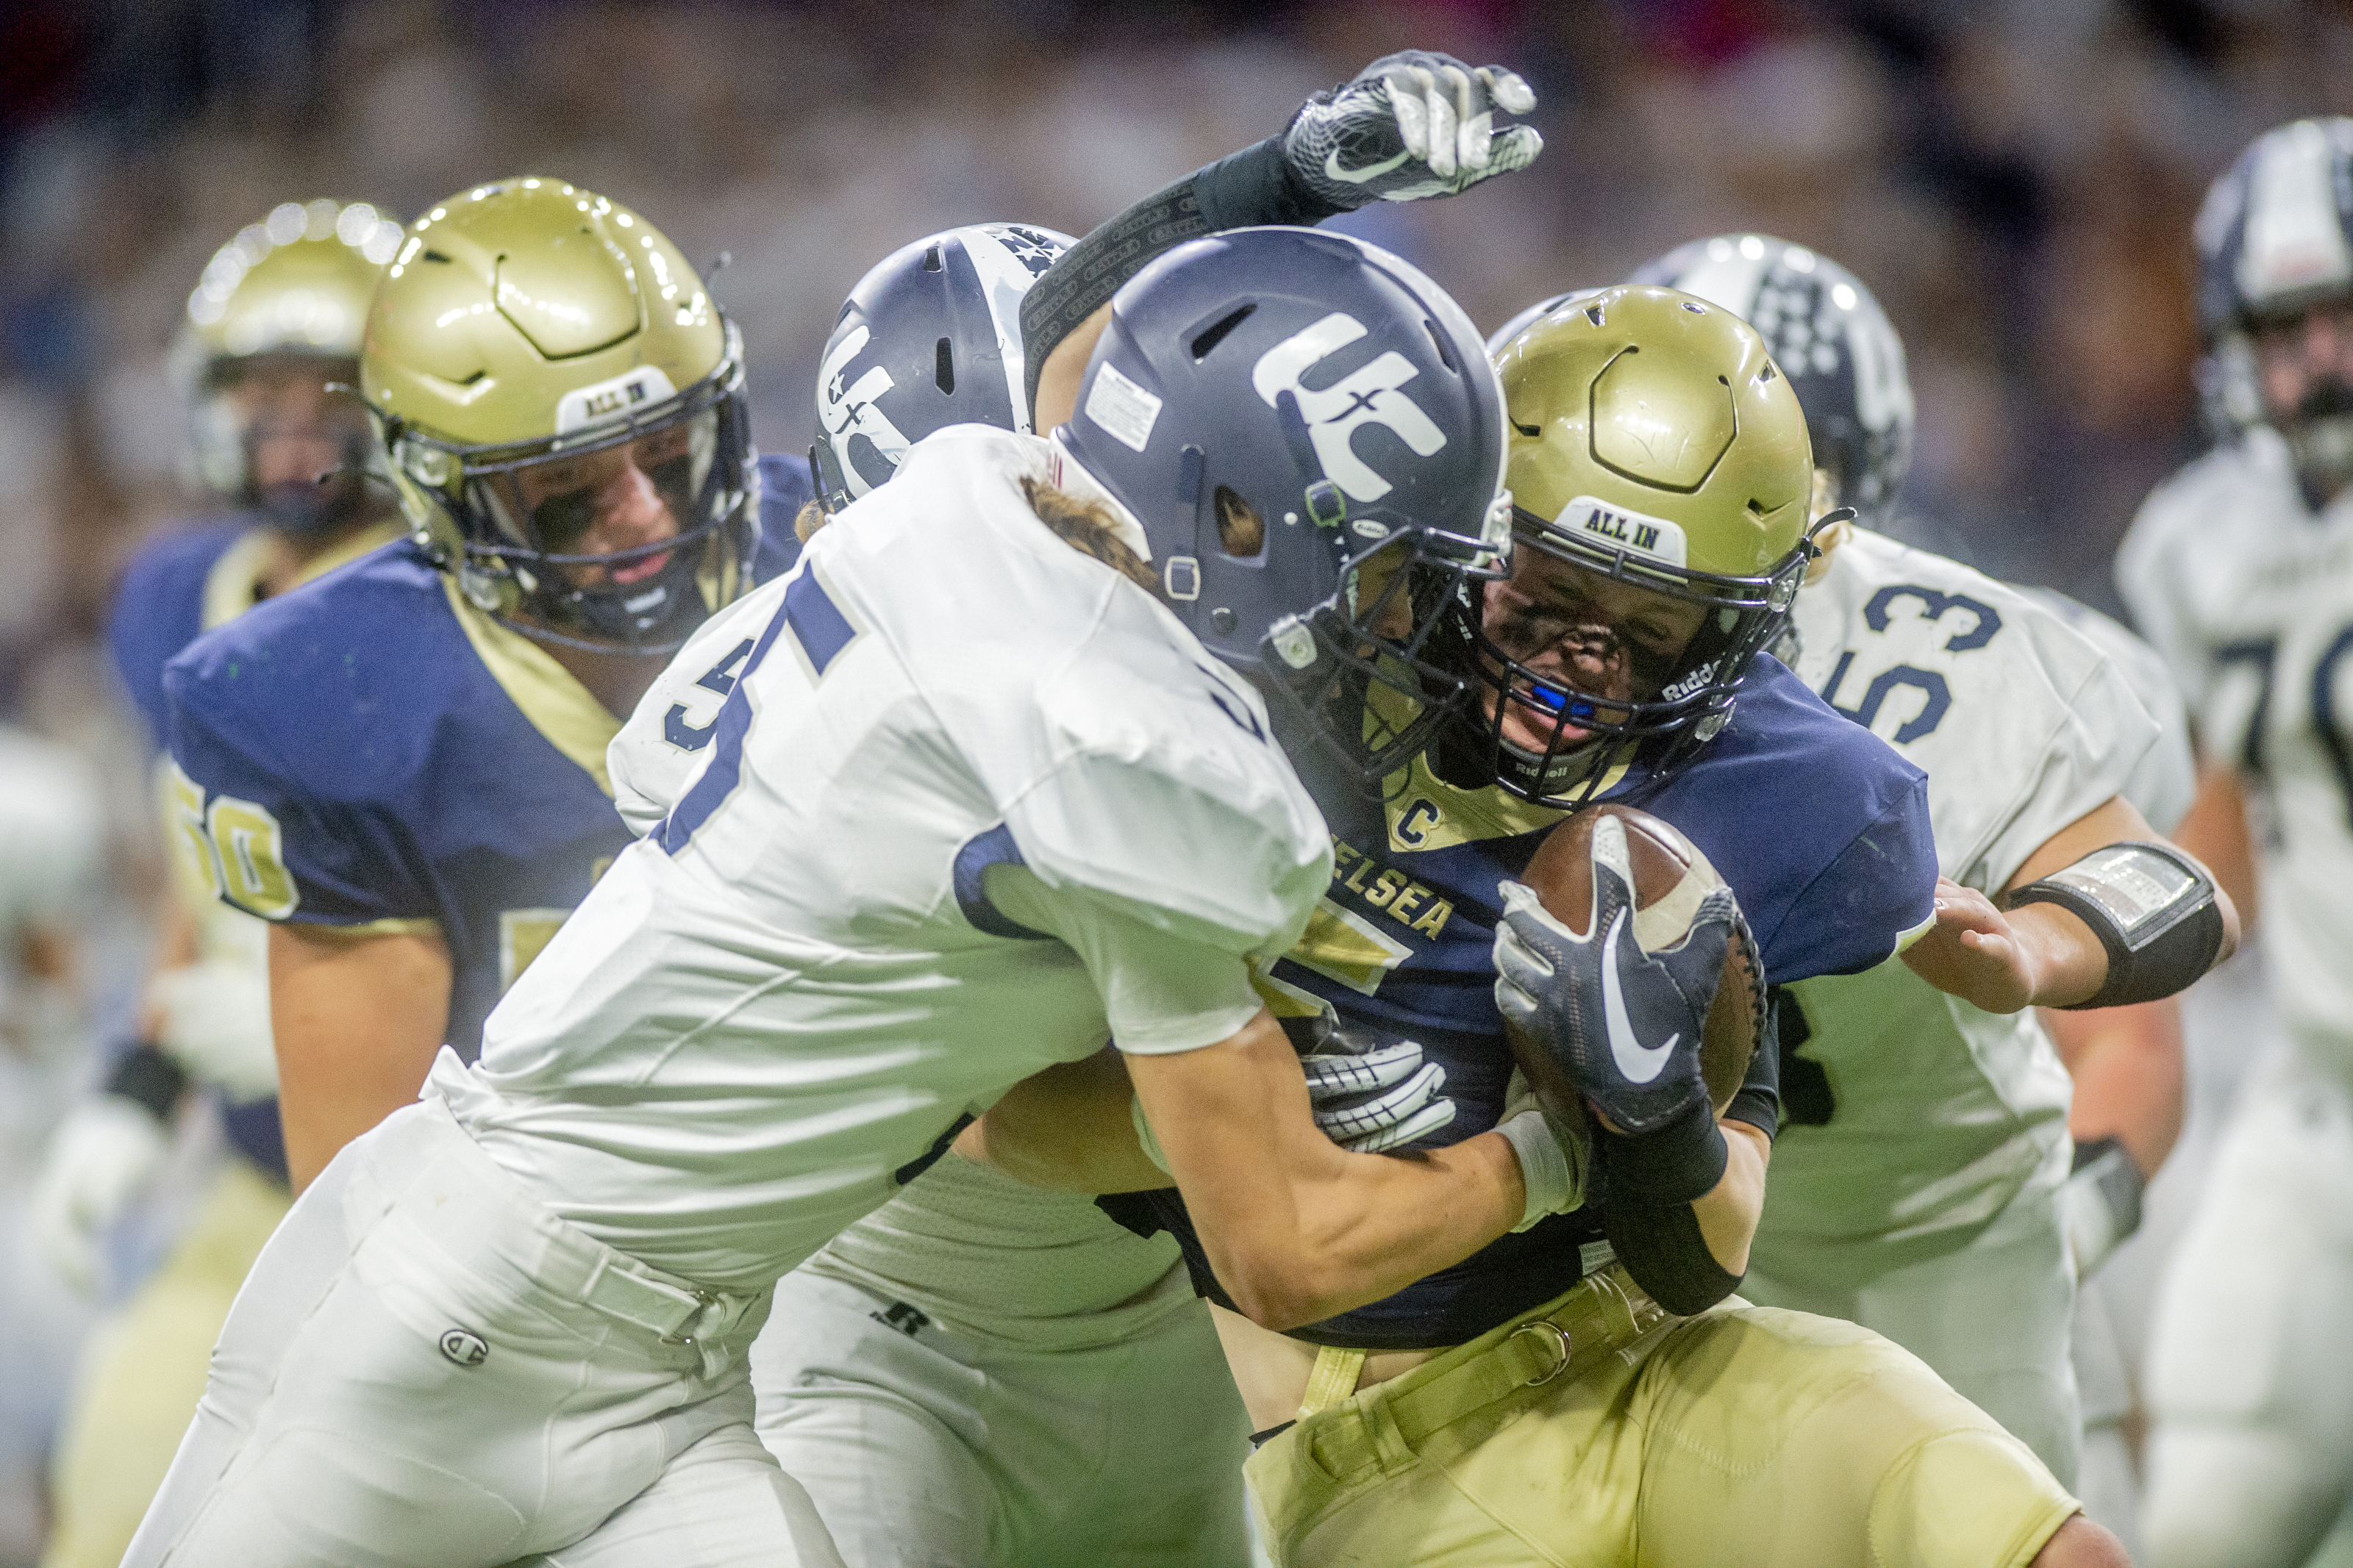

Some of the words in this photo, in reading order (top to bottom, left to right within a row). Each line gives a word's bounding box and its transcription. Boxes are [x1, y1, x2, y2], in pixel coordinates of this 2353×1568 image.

[1585, 508, 1627, 542] ALL
[1632, 523, 1660, 551] IN
[1661, 651, 1727, 701] Ridd
[1819, 584, 2005, 745] 53
[1392, 797, 1443, 847] C
[1329, 833, 1455, 941] ELSEA
